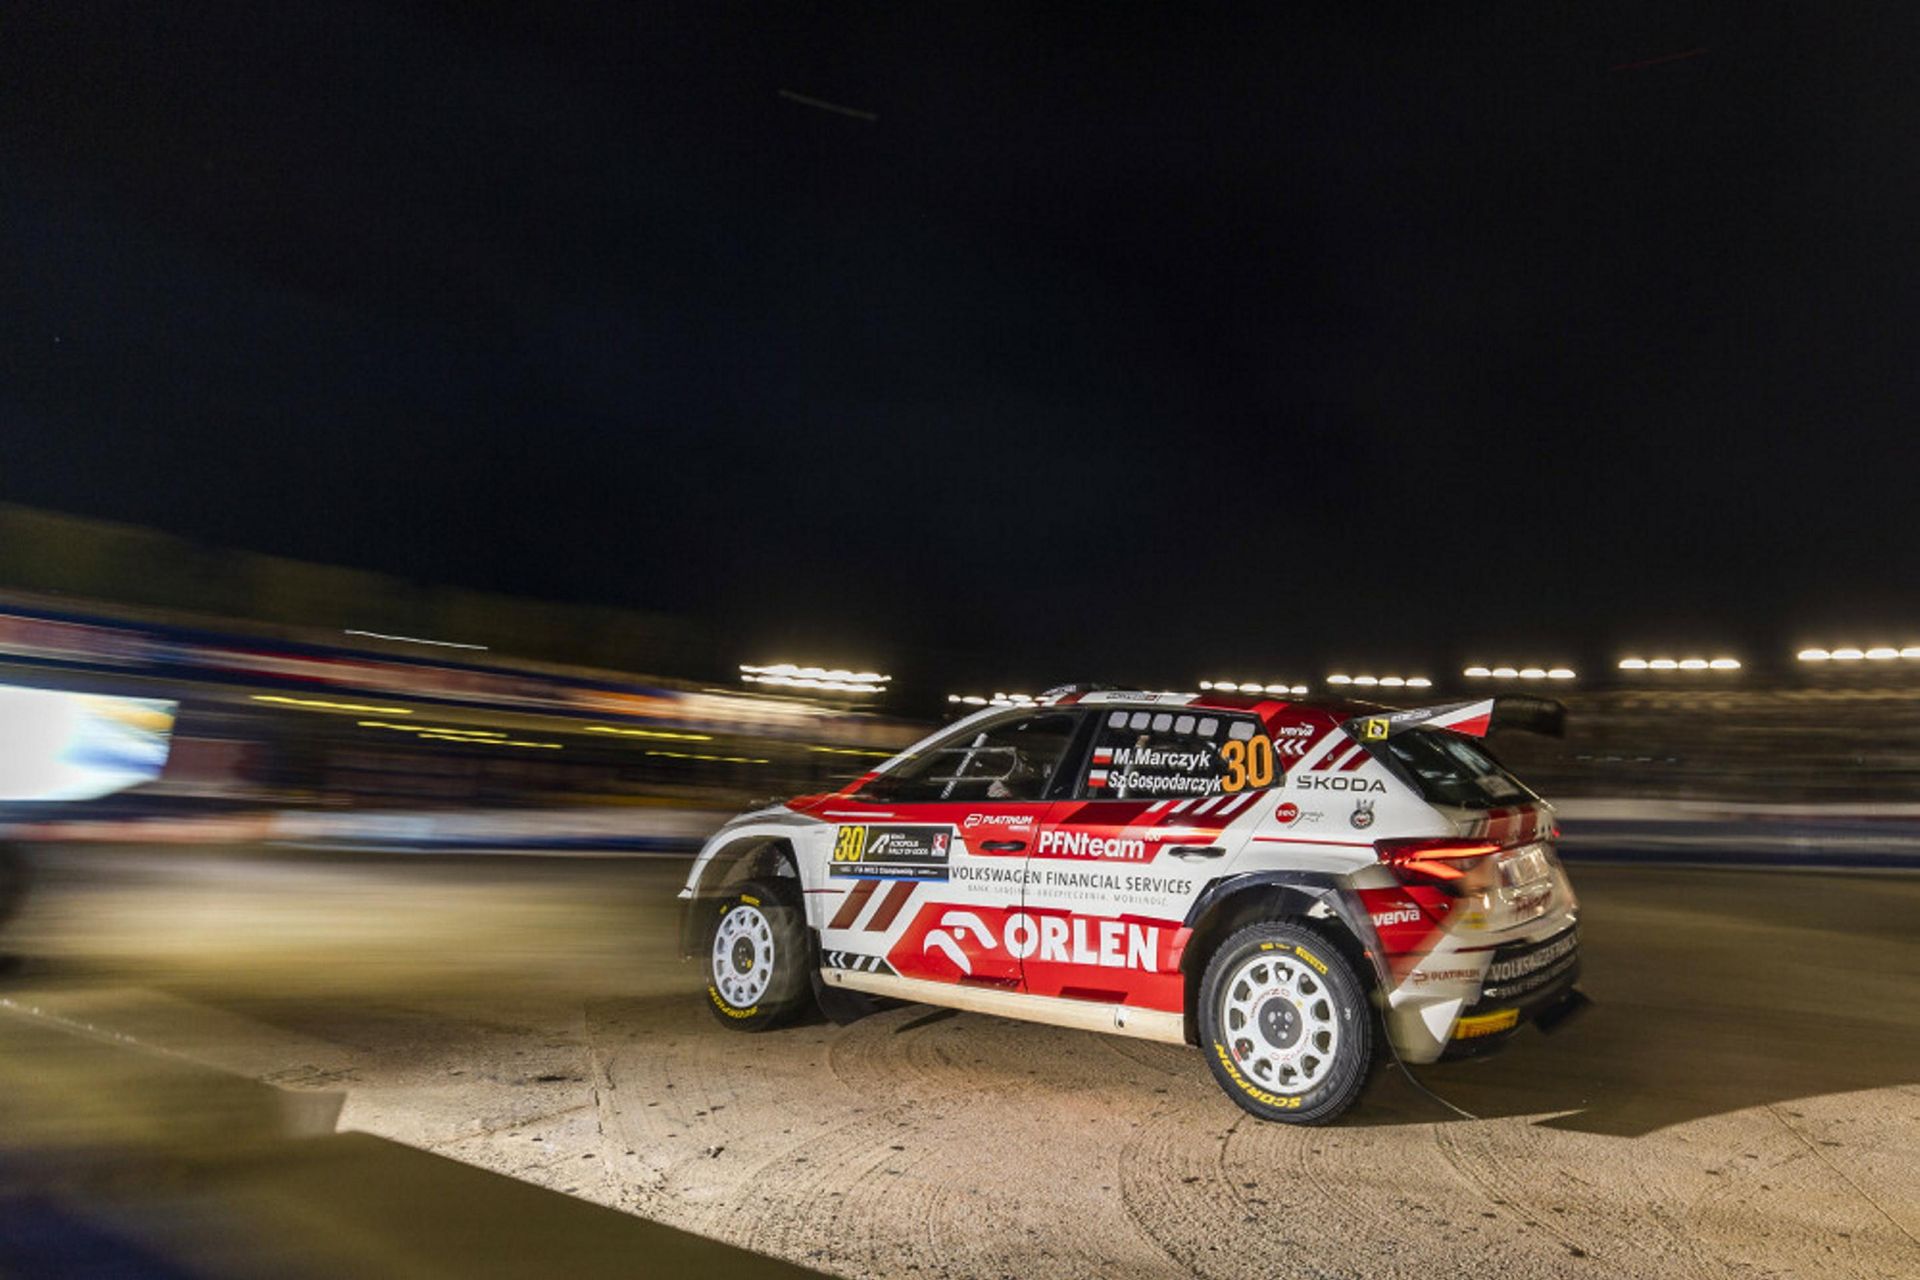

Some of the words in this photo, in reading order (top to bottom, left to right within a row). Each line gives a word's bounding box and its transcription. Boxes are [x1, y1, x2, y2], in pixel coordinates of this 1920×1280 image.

[1113, 748, 1211, 770] M.Marczyk
[1220, 735, 1274, 792] 30
[982, 815, 1034, 826] PLATINUM
[835, 825, 864, 862] 30
[1038, 830, 1145, 859] PFNteam
[951, 866, 1042, 884] VOLKSWAGEN
[1046, 871, 1121, 890] FINANCIAL
[1126, 876, 1193, 895] SERVICES
[1373, 909, 1421, 927] verva
[1003, 913, 1160, 973] ORLEN
[1213, 1040, 1302, 1109] SCORPION
